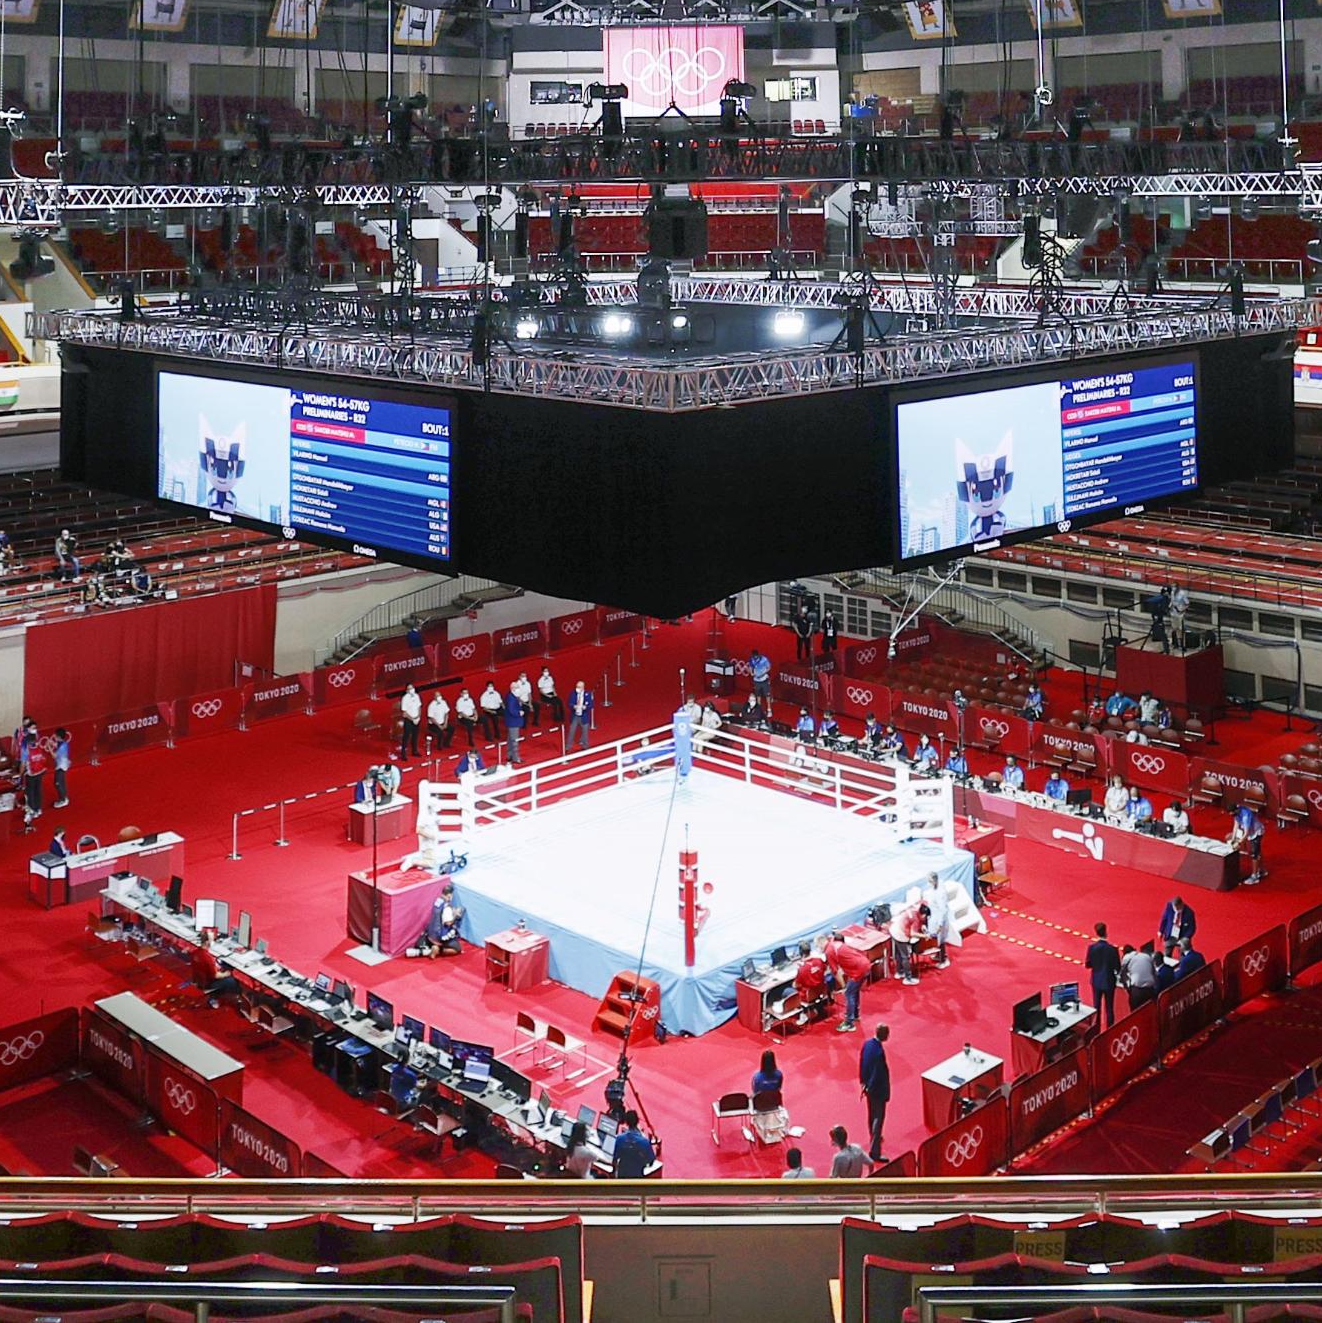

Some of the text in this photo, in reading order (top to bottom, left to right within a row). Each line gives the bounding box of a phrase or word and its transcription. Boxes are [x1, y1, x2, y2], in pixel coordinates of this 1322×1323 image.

[302, 392, 370, 412] WOMEN'S 54-57KG
[422, 423, 449, 436] BOUT:1
[523, 630, 538, 642] 2020
[384, 656, 425, 672] TOKYO 2020
[780, 672, 801, 686] TOKYO
[254, 684, 299, 702] TOKYO 2020
[903, 701, 948, 720] TOKYO 2020
[108, 715, 158, 734] TOKYO 2020
[1299, 920, 1322, 943] TOKYO
[90, 1029, 113, 1057] TOKYO
[1023, 1071, 1077, 1115] TOKYO 2020
[232, 1124, 288, 1173] TOKYO 2020
[1015, 1240, 1063, 1256] PRESS
